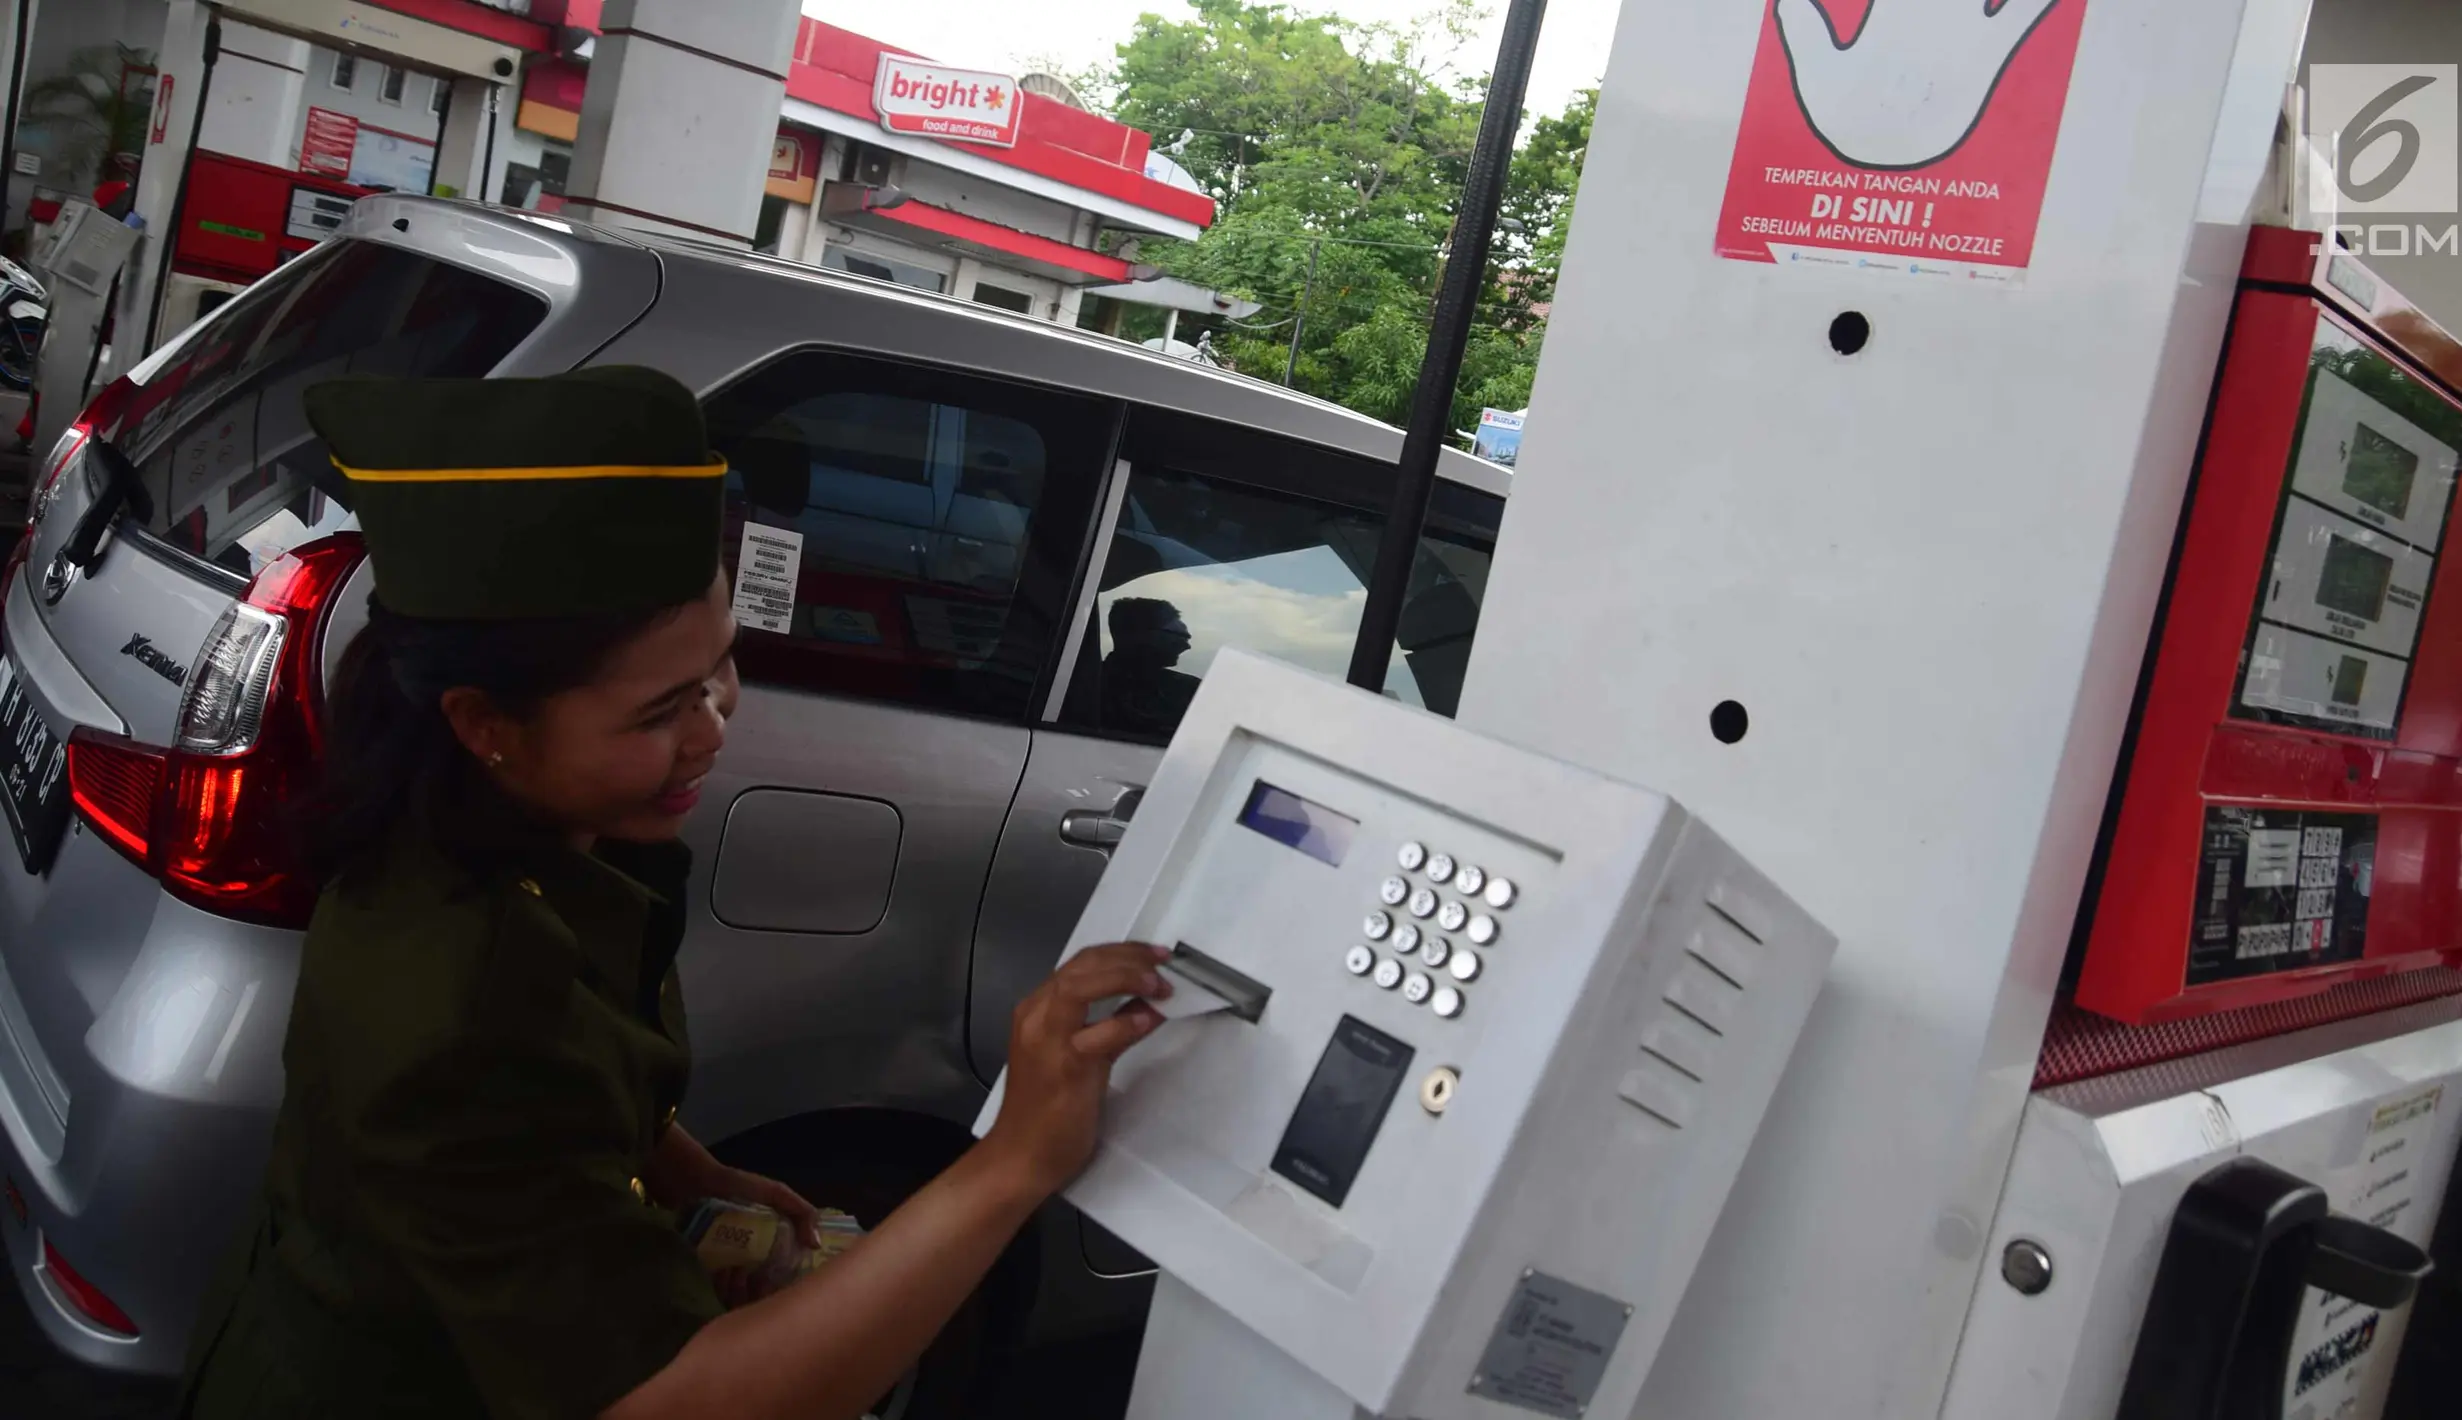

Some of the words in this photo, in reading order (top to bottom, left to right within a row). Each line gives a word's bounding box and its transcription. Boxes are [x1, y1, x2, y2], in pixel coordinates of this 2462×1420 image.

[890, 70, 979, 109] bright
[923, 119, 949, 131] food
[950, 121, 969, 134] and
[971, 124, 999, 139] drink
[1764, 167, 1859, 190] TEMPELKAN
[1863, 173, 1941, 195] TANGAN
[1944, 180, 2000, 200] ANDA
[1810, 193, 1841, 220] DI
[1849, 197, 1915, 226] SINI
[1741, 216, 1811, 238] SEBELUM
[1815, 223, 1926, 249] MENYENTUH
[1929, 234, 2004, 256] NOZZLE
[1492, 415, 1521, 427] SUZUKI
